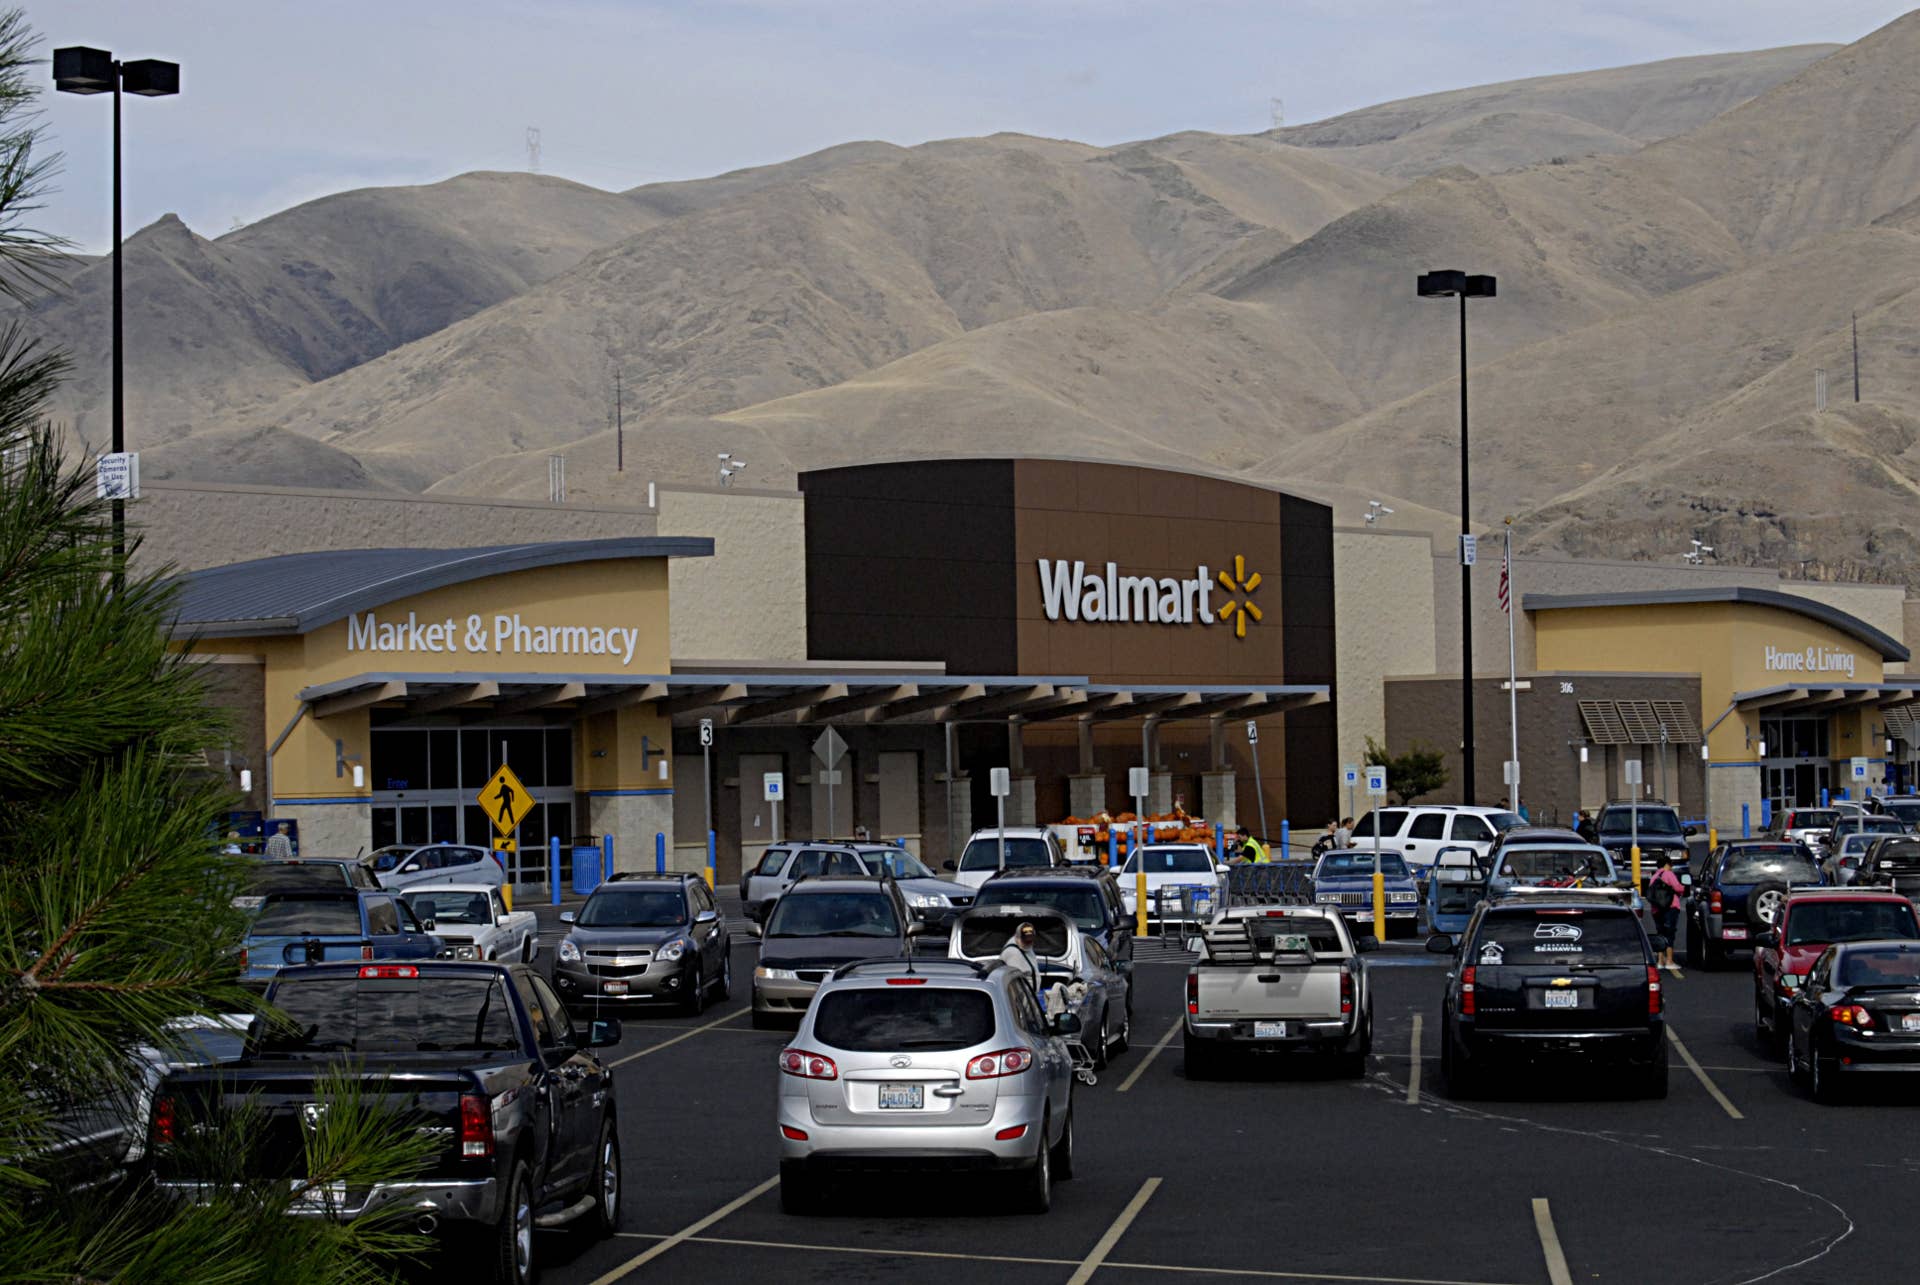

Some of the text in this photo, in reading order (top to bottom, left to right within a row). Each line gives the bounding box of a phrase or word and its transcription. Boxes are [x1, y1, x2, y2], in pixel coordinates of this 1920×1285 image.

[101, 457, 126, 465] Security
[1038, 559, 1214, 624] Walmart
[347, 612, 638, 665] Market & Pharmacy
[1765, 646, 1855, 677] Home & Living
[1560, 681, 1573, 693] 306
[703, 726, 711, 744] 3
